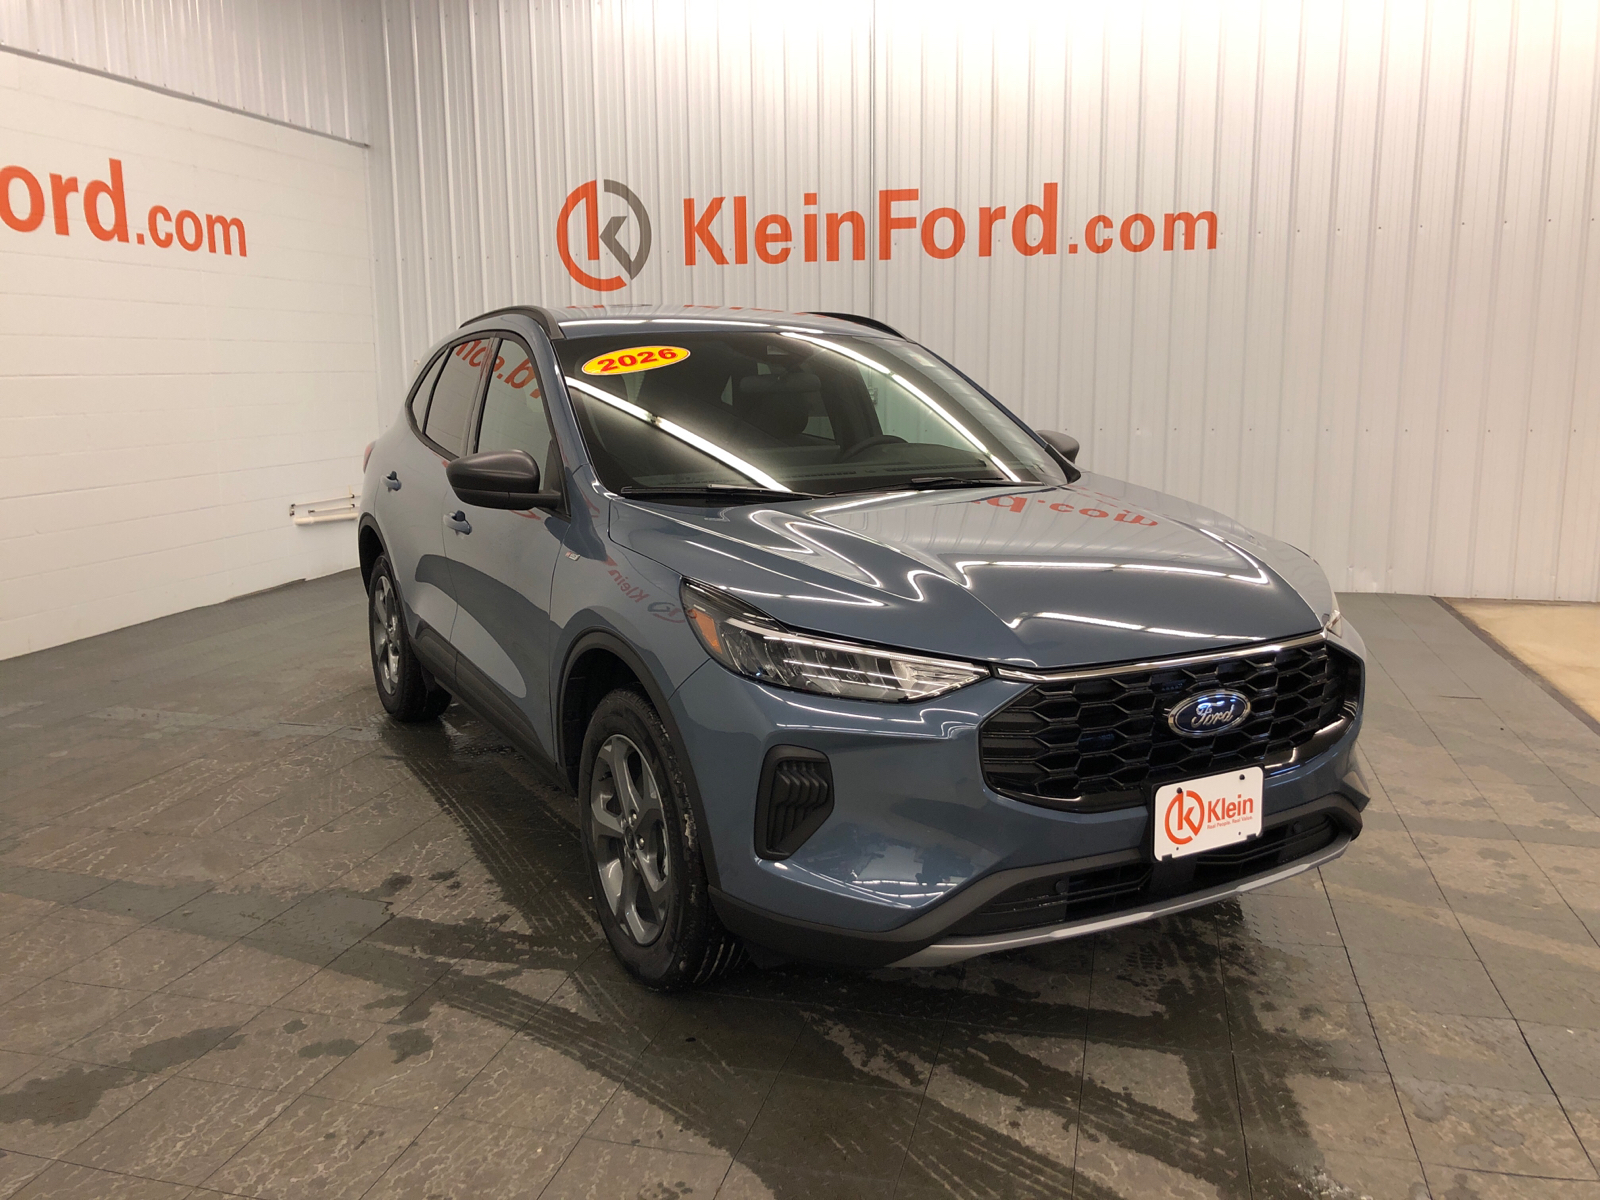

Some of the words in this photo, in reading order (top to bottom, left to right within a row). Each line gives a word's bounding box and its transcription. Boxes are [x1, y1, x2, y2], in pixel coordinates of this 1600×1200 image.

[683, 181, 1218, 266] KleinFord.com
[597, 348, 678, 372] 2026
[1190, 701, 1236, 729] Ford
[1207, 793, 1254, 824] Klein
